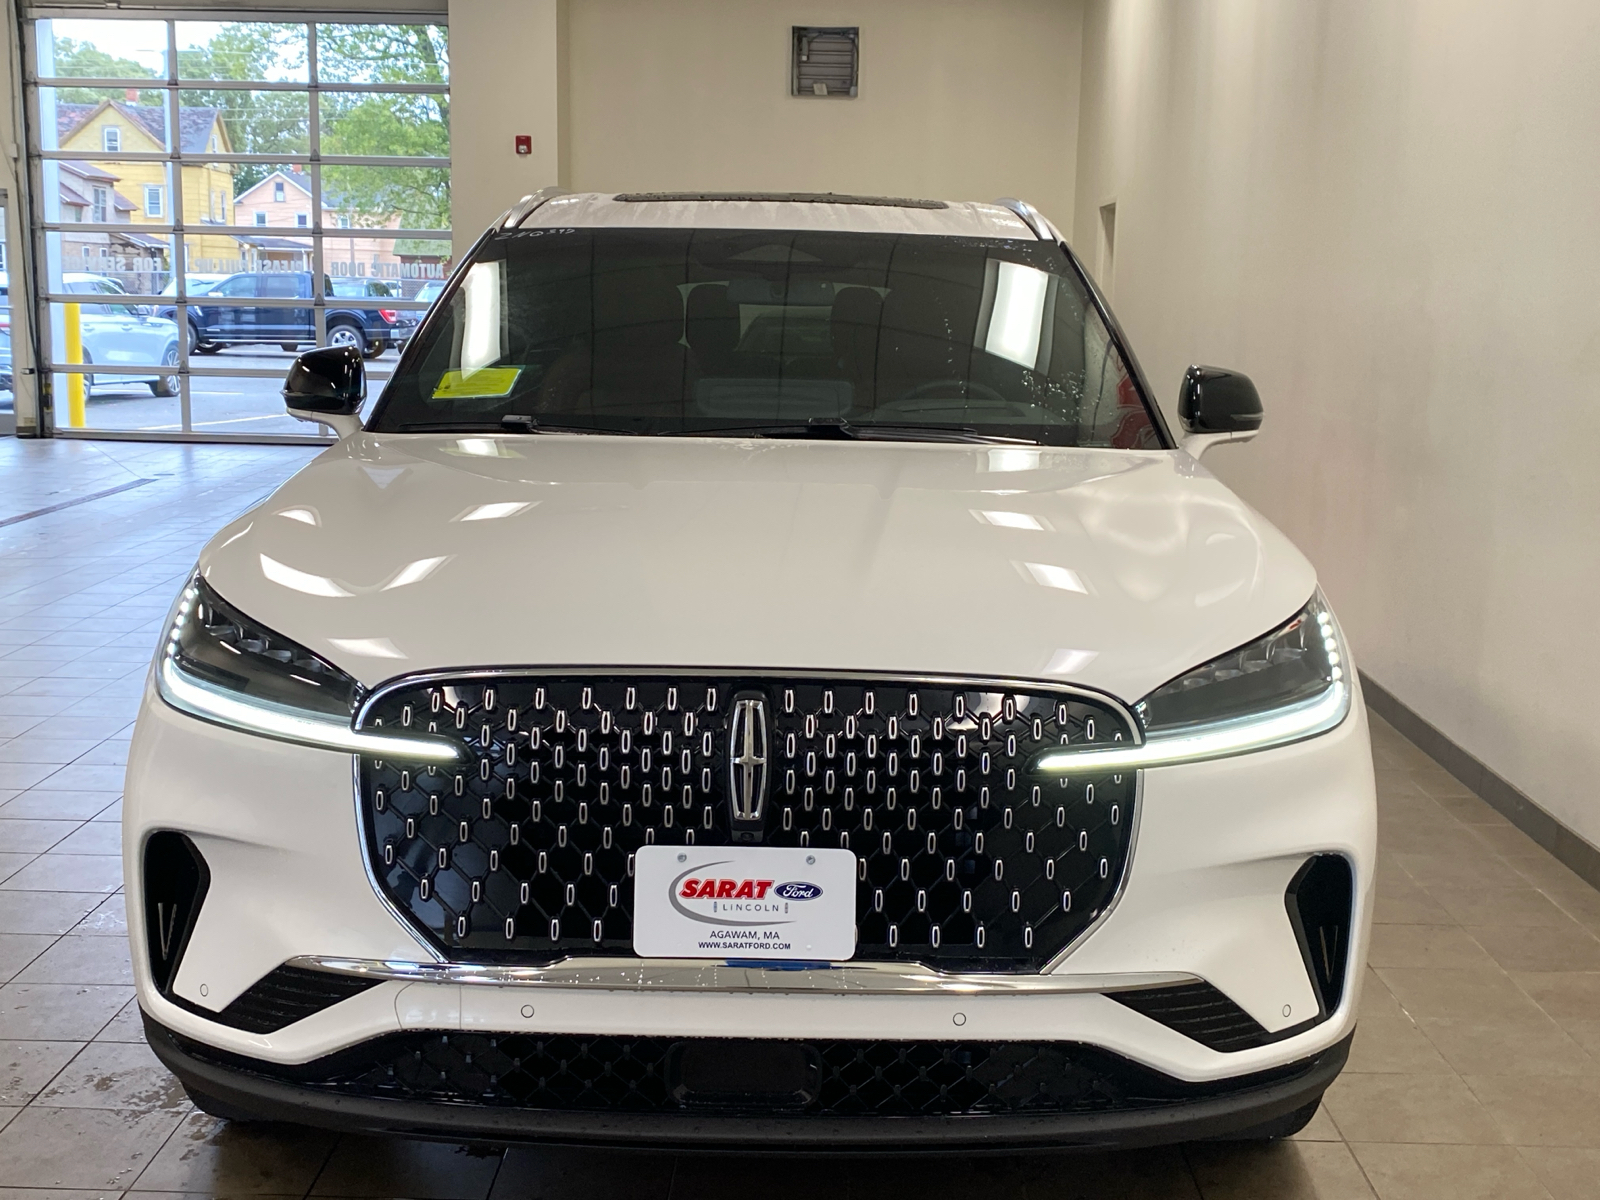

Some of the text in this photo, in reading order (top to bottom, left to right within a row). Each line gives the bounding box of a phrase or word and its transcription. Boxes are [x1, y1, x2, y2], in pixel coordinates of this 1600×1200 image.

[679, 878, 775, 900] SARAT
[722, 903, 780, 912] LINCOLN
[709, 930, 780, 941] AGAWAM, MA
[698, 941, 791, 950] WWW.SARATFORD.COM
